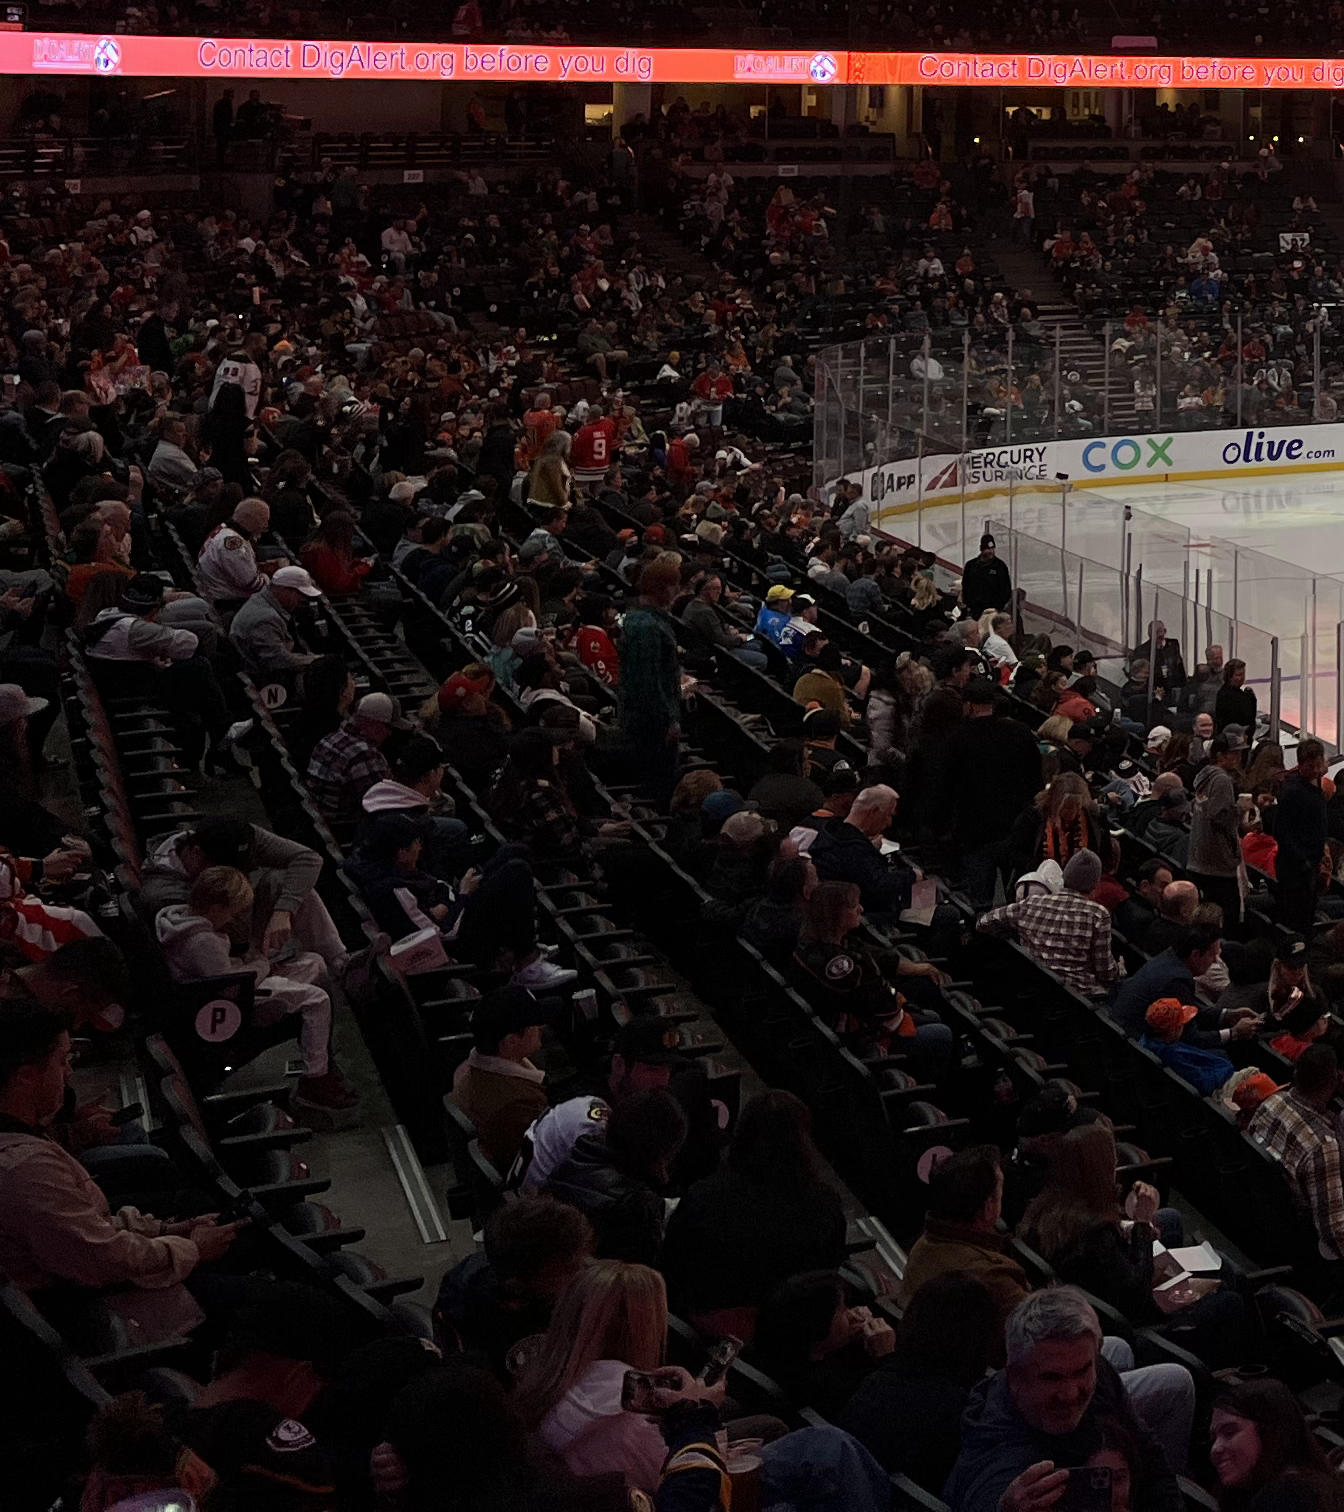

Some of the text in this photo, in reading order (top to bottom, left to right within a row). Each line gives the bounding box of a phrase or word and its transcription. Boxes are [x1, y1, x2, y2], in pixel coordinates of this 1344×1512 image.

[199, 40, 653, 80] Contact DigAlert.org before you dig
[919, 55, 1018, 80] Contact
[1027, 56, 1173, 86] DigAlert.org
[1181, 59, 1255, 82] before
[1263, 64, 1303, 87] you
[1082, 436, 1175, 474] COX
[267, 687, 278, 705] N
[210, 1007, 227, 1035] P
